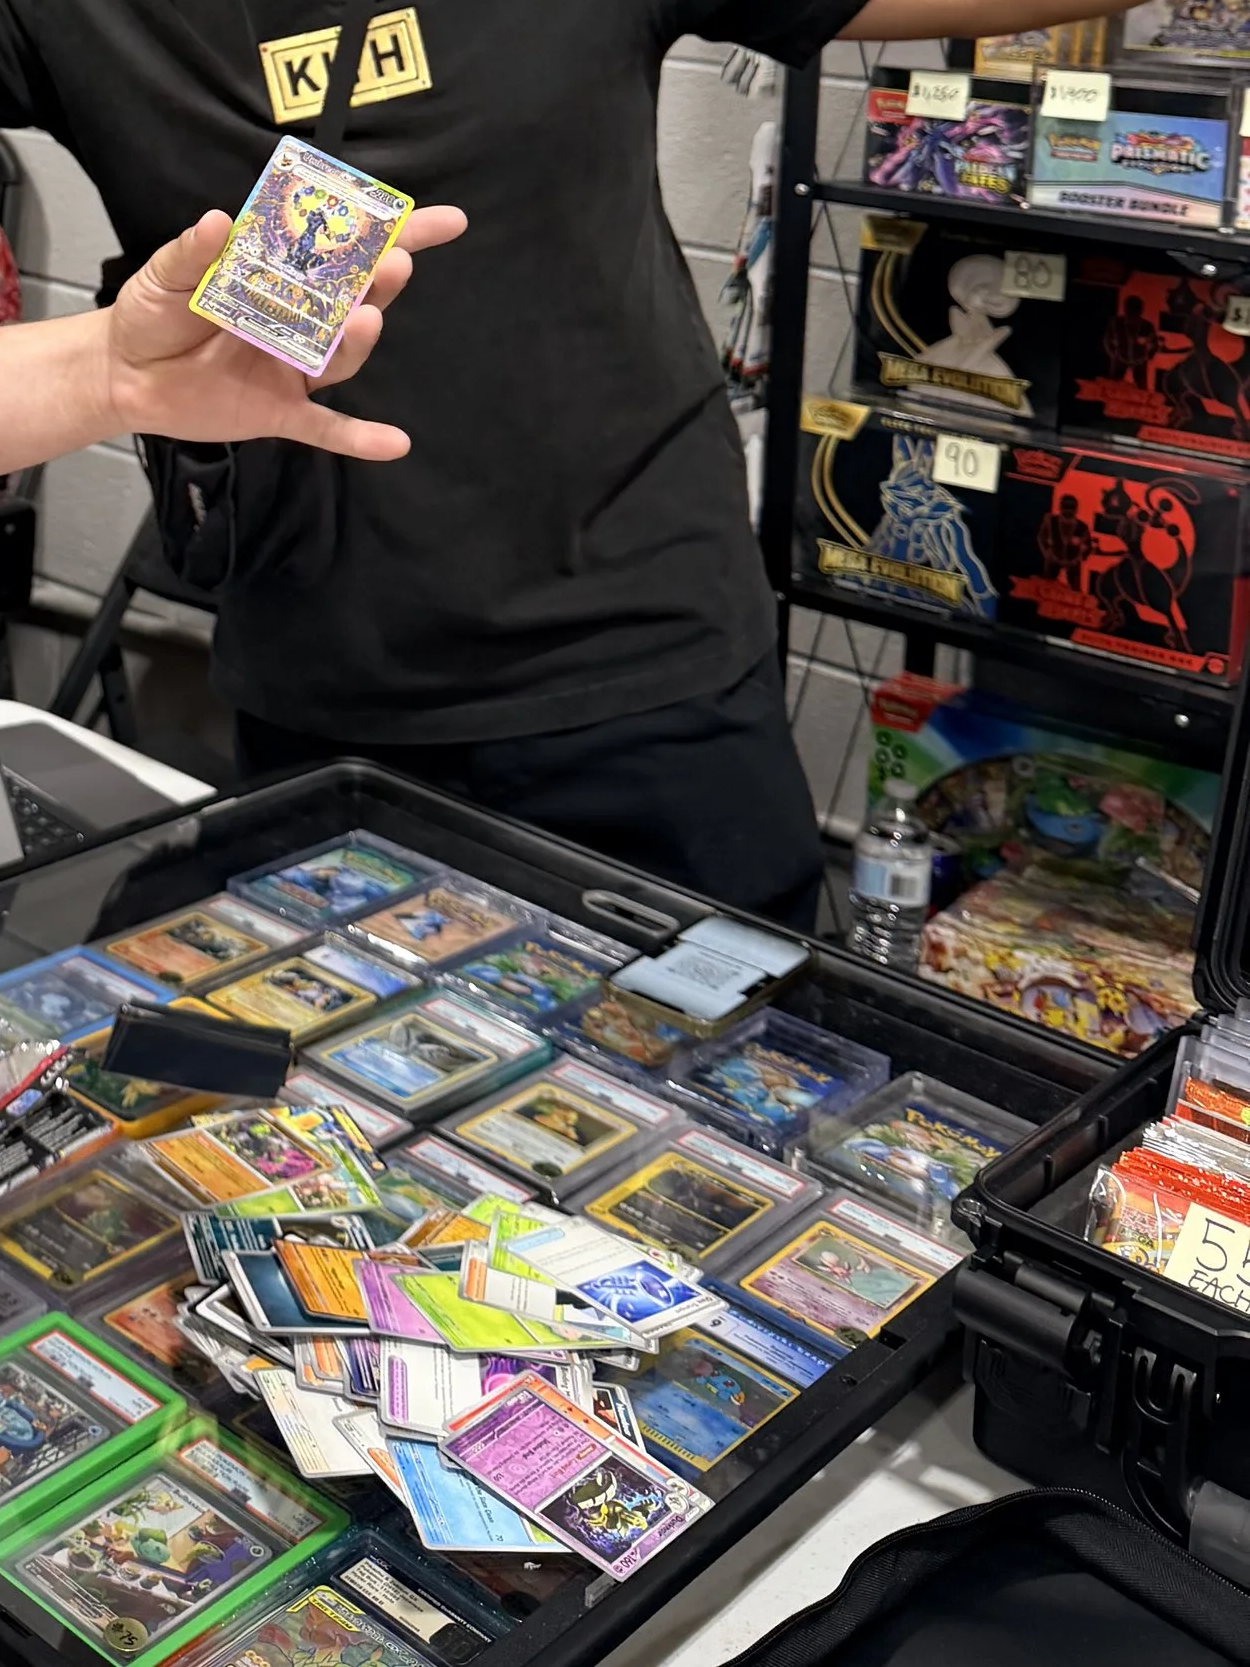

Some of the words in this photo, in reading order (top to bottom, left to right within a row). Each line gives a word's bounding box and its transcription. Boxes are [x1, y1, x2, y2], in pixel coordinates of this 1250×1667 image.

[284, 33, 405, 98] KH
[1058, 189, 1125, 209] BOOSTER
[1129, 197, 1189, 217] BUNDLE
[1014, 255, 1050, 289] 80
[944, 440, 980, 478] 90
[905, 1106, 1003, 1159] Pokémon
[1188, 1269, 1250, 1313] EACH
[657, 1515, 685, 1537] Dusknoir
[619, 1554, 637, 1569] 160
